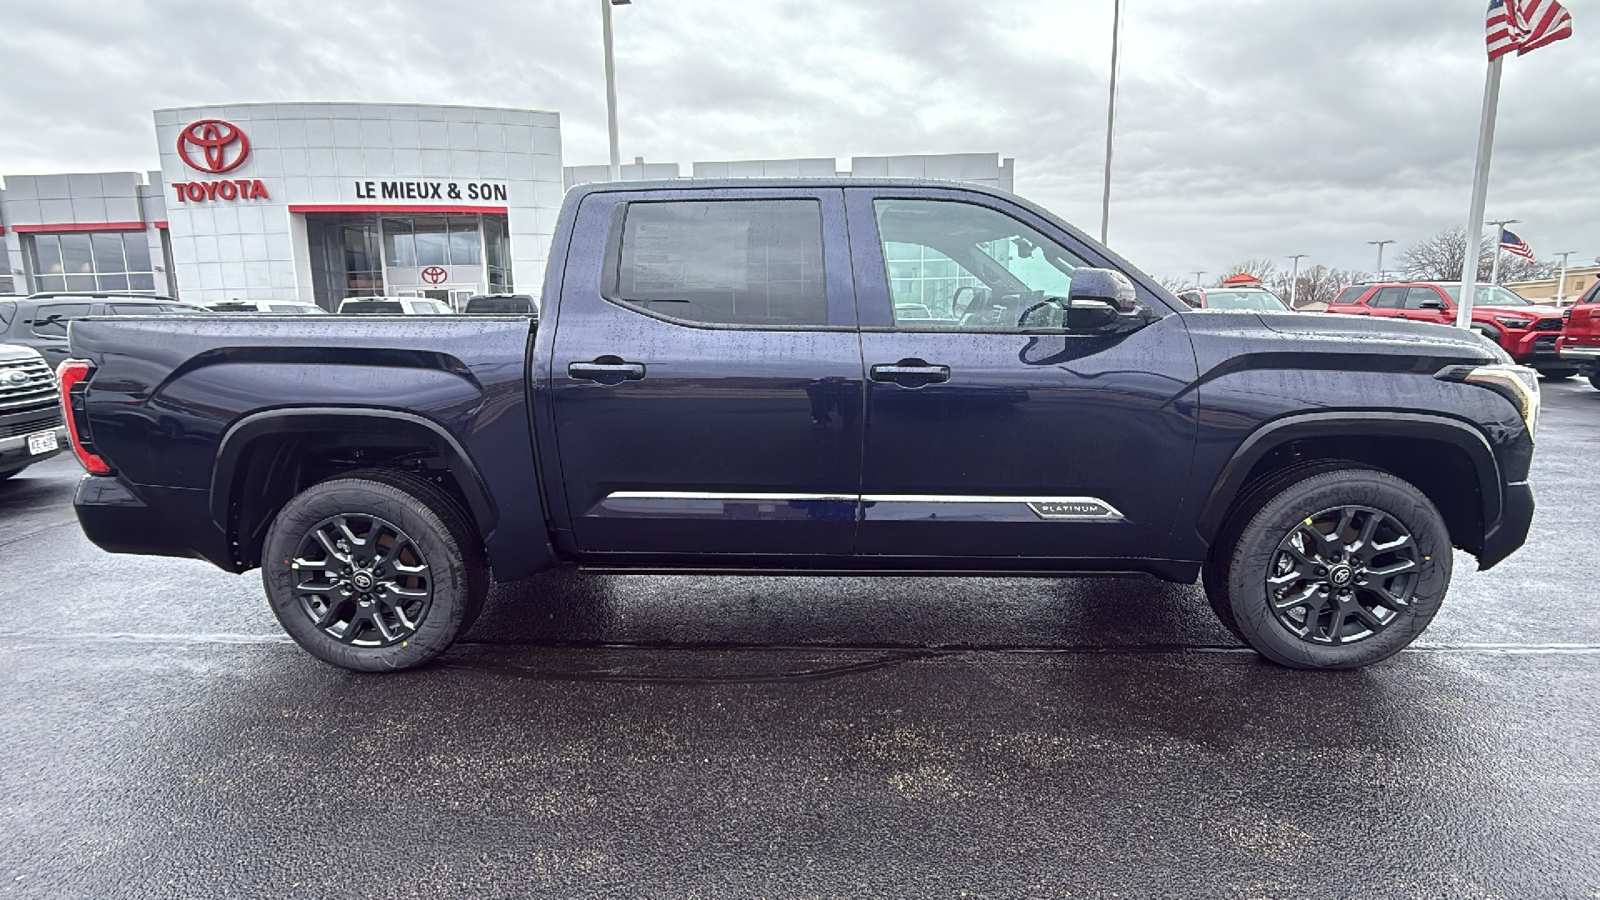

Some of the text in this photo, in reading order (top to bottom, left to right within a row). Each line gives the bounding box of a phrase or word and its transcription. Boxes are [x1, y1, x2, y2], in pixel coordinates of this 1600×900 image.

[172, 179, 270, 203] TOYOTA
[355, 181, 508, 201] LE MIEUX & SON
